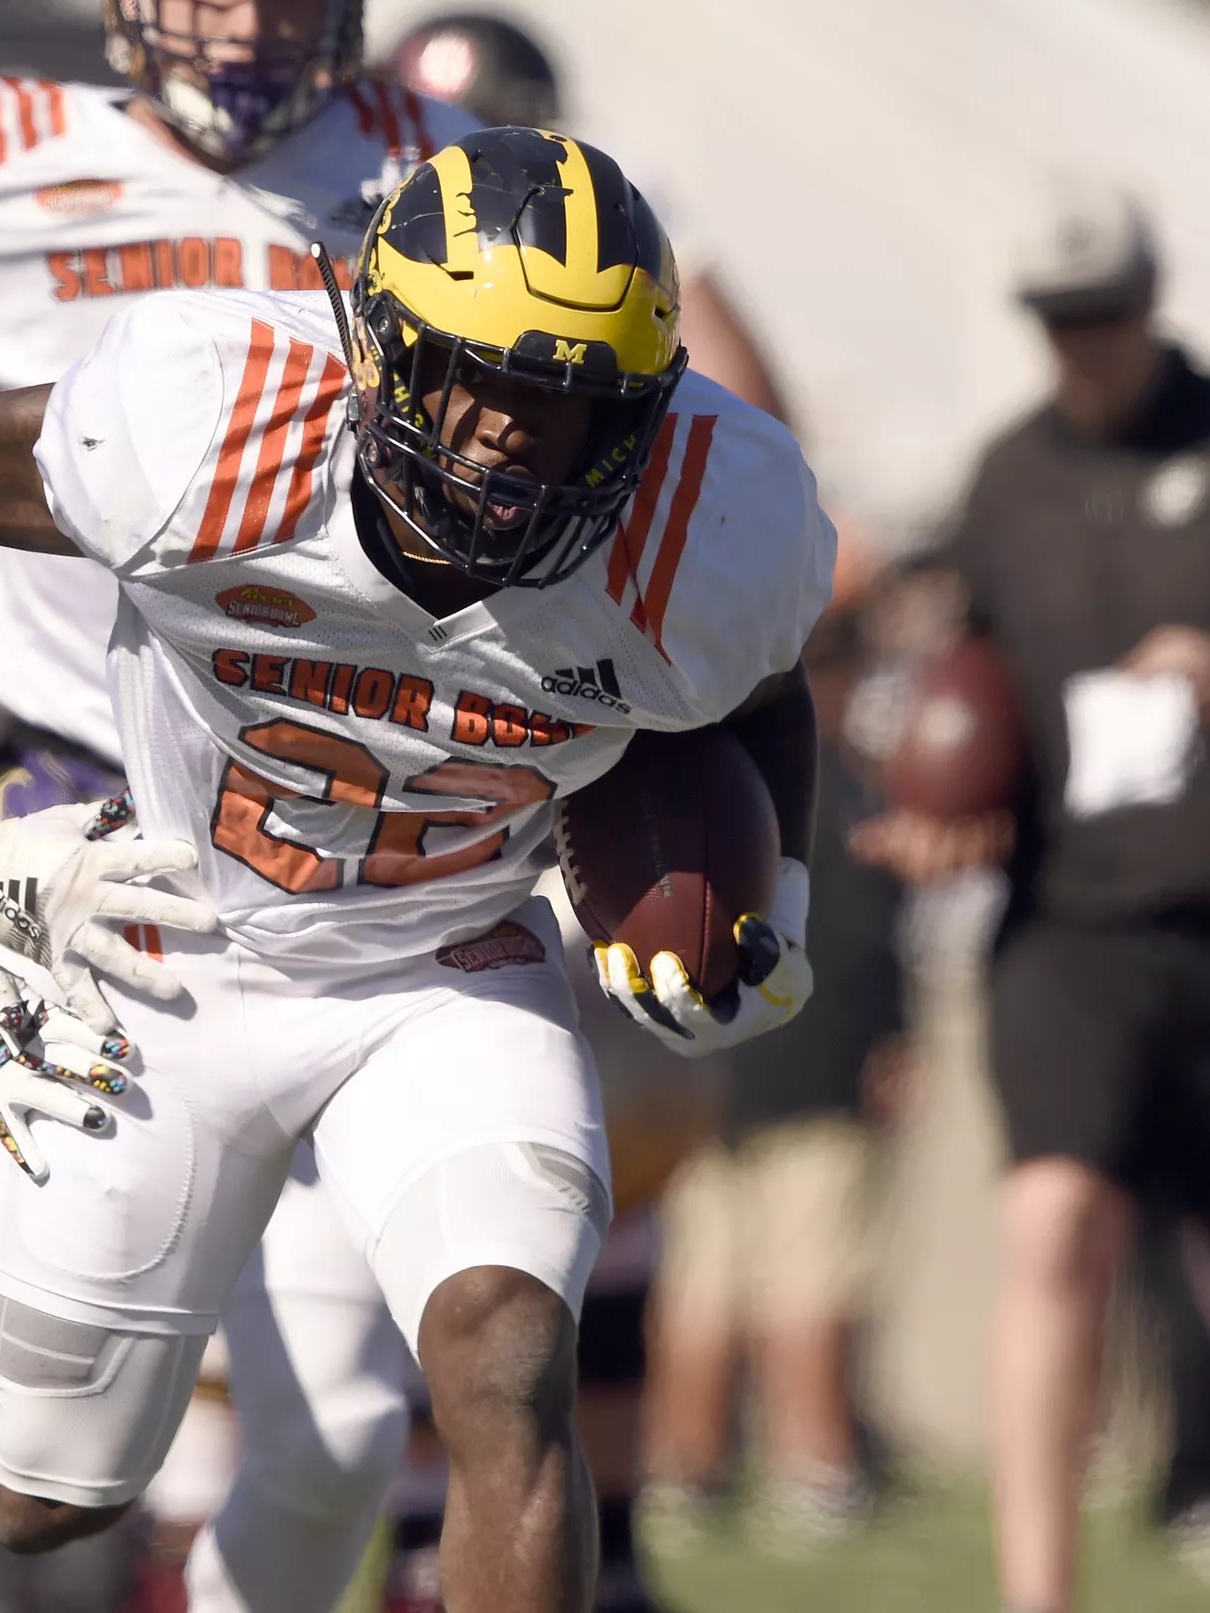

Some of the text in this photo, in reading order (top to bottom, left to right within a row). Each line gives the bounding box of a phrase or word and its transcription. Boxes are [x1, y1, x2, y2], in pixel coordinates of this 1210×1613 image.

[47, 237, 243, 302] SENIOR
[552, 339, 588, 365] M
[211, 648, 435, 732] SENIOR
[541, 675, 632, 715] adidas
[210, 716, 558, 895] 22
